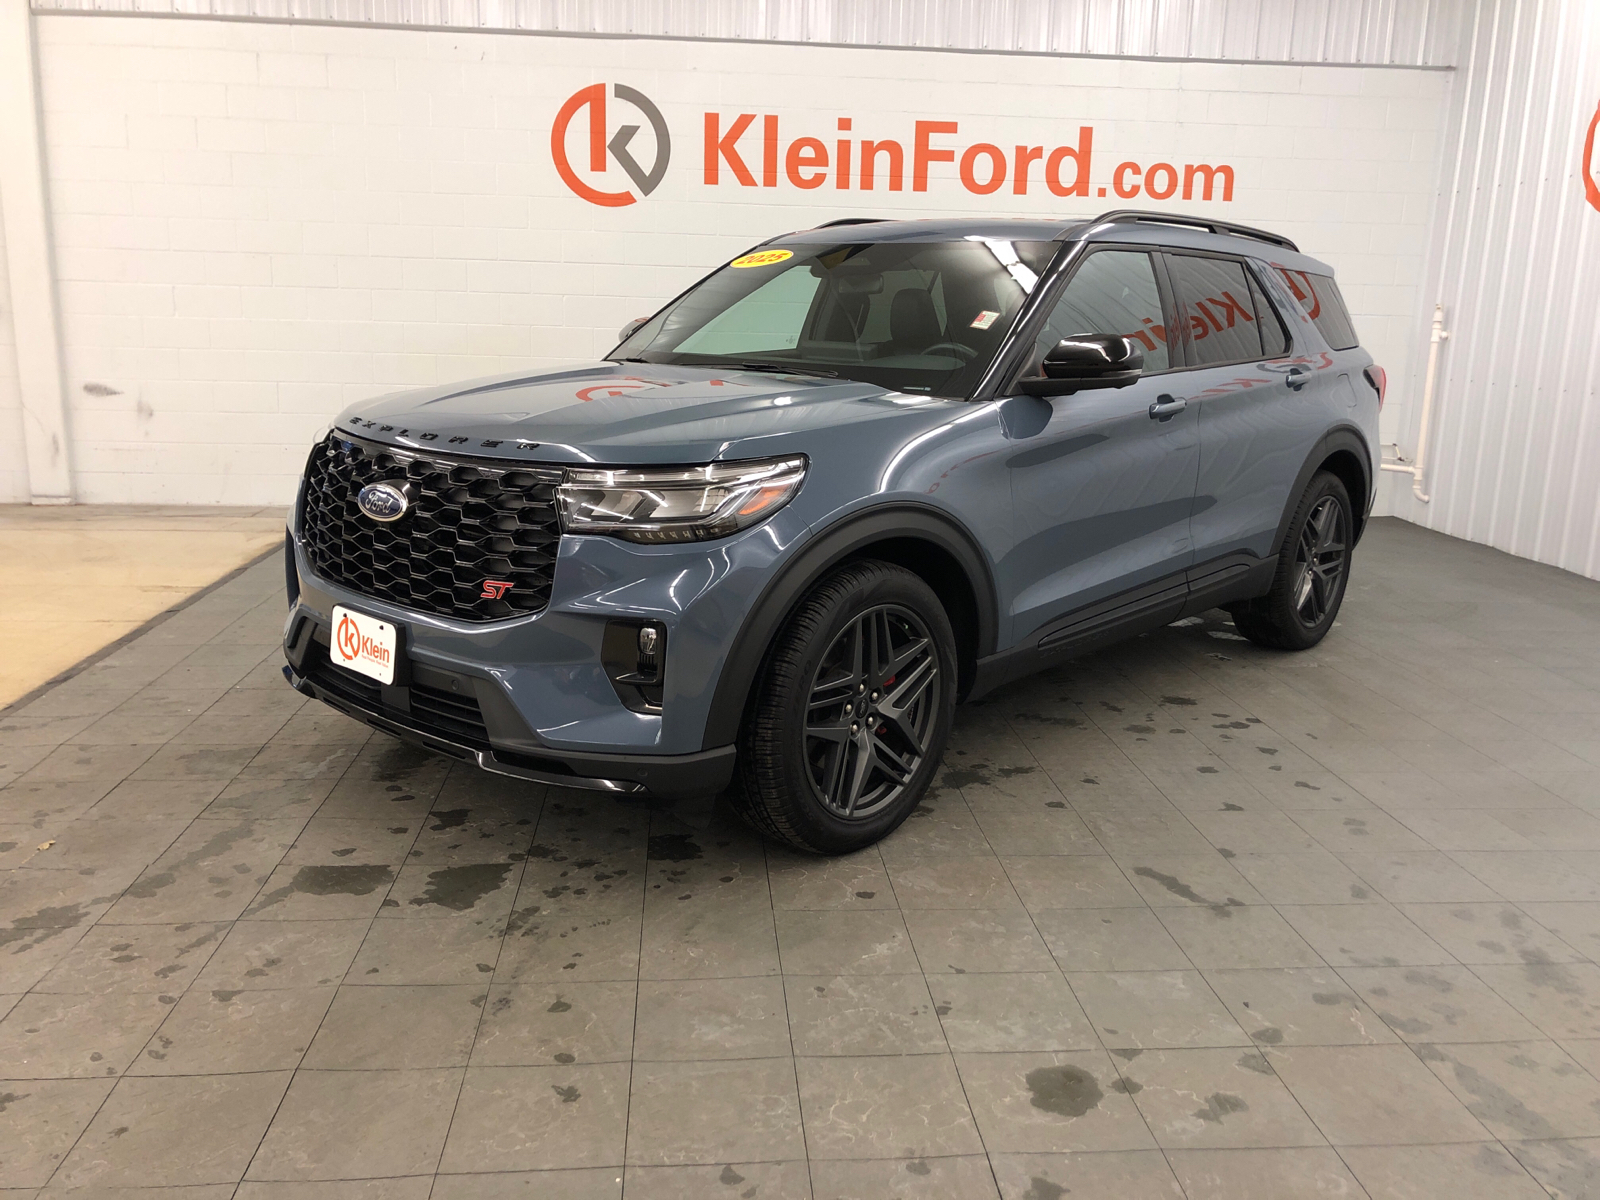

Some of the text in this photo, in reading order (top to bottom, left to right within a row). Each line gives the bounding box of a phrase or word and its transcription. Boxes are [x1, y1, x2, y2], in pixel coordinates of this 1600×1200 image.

[703, 111, 1235, 203] KleinFord.com
[735, 253, 789, 265] 2025
[350, 416, 541, 451] EXPLORER
[365, 490, 395, 514] Ford
[480, 580, 515, 600] ST
[361, 634, 390, 663] Klein
